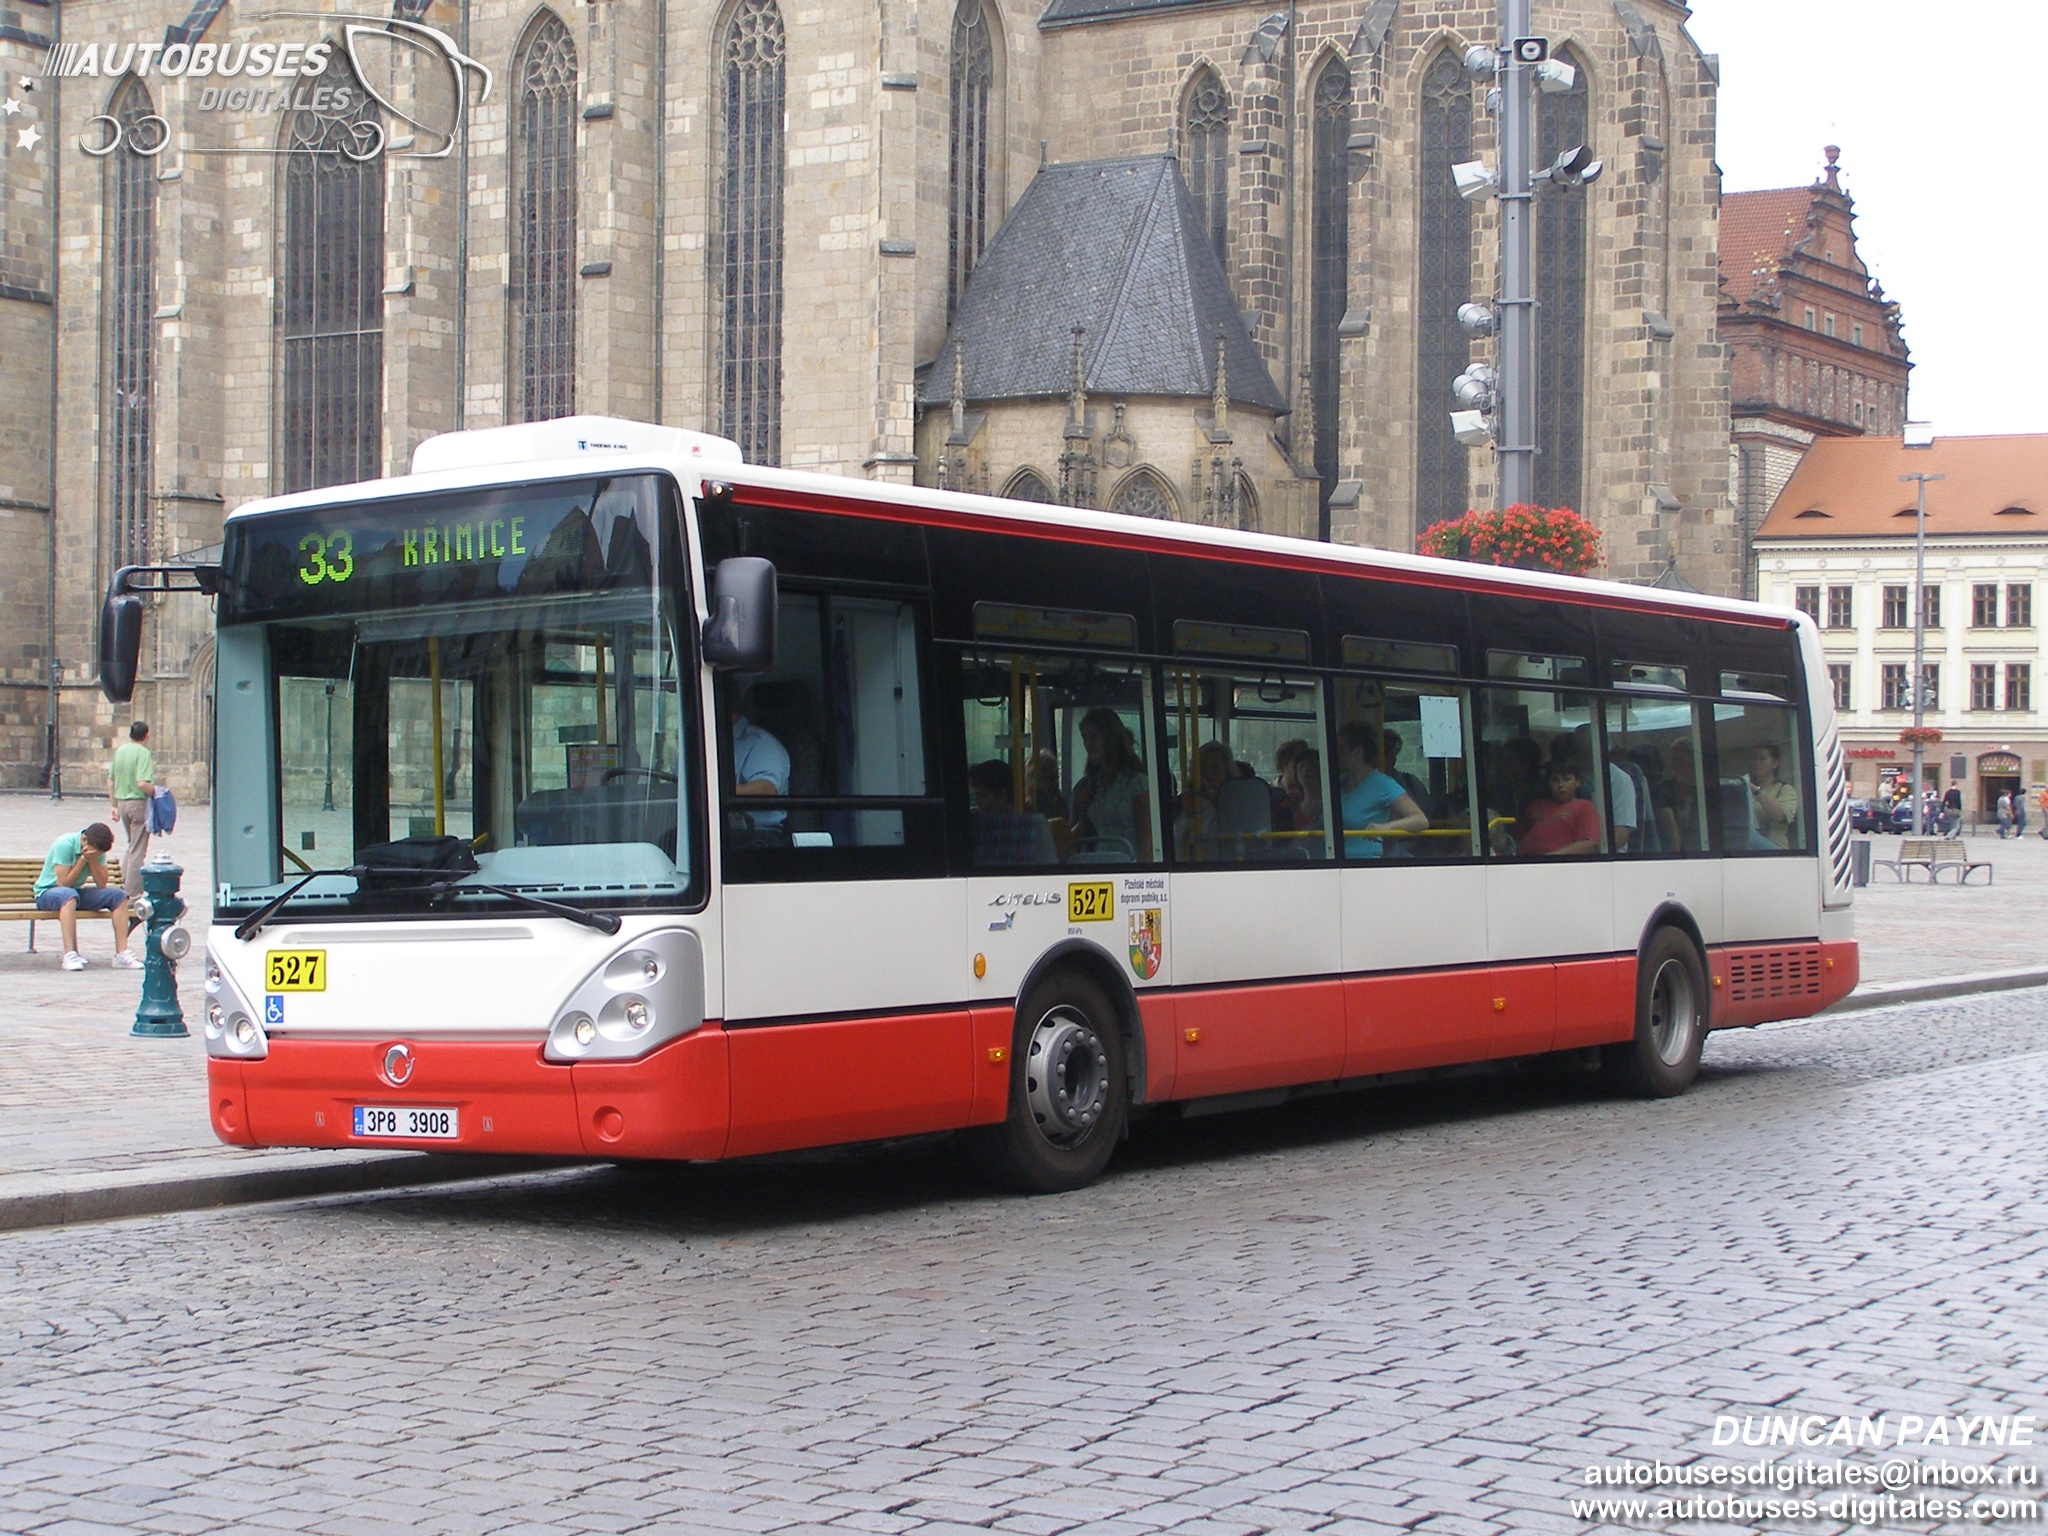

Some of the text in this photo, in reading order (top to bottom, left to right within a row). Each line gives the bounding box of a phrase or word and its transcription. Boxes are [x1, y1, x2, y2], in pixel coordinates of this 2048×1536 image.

[403, 516, 526, 567] KŘIMICE
[300, 529, 354, 585] 33
[1847, 748, 1896, 759] vodafone
[1124, 878, 1165, 889] Plzeňské městské
[1073, 888, 1109, 916] 527
[1120, 892, 1141, 905] dopravní
[271, 956, 319, 985] 527
[367, 1110, 449, 1133] 3P8 3908
